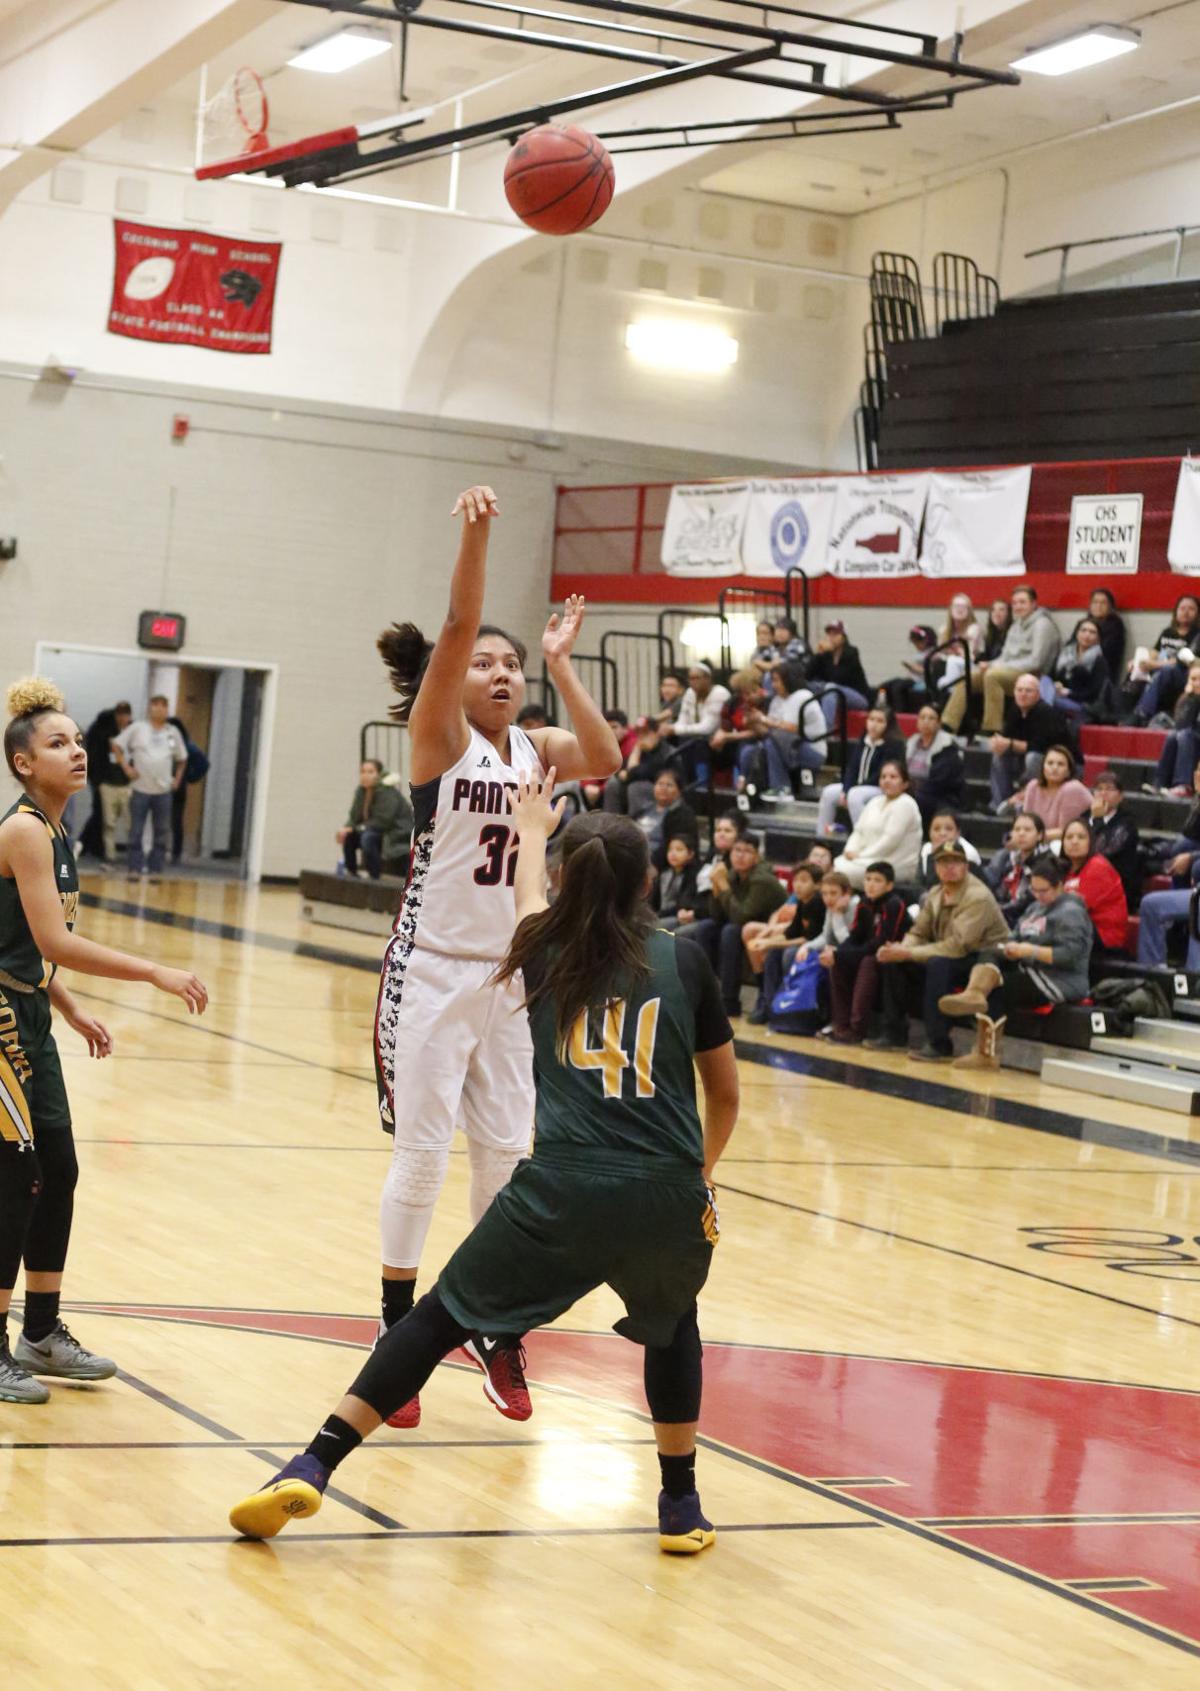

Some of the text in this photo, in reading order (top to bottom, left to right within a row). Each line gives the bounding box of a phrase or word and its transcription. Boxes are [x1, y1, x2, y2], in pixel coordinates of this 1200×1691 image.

[230, 249, 272, 264] SCHOOL
[1095, 505, 1117, 521] CHS
[829, 505, 876, 549] Nationwide
[1075, 524, 1135, 543] STUDENT
[1079, 549, 1127, 565] SECTION
[452, 778, 542, 815] PANT
[568, 996, 660, 1099] 41
